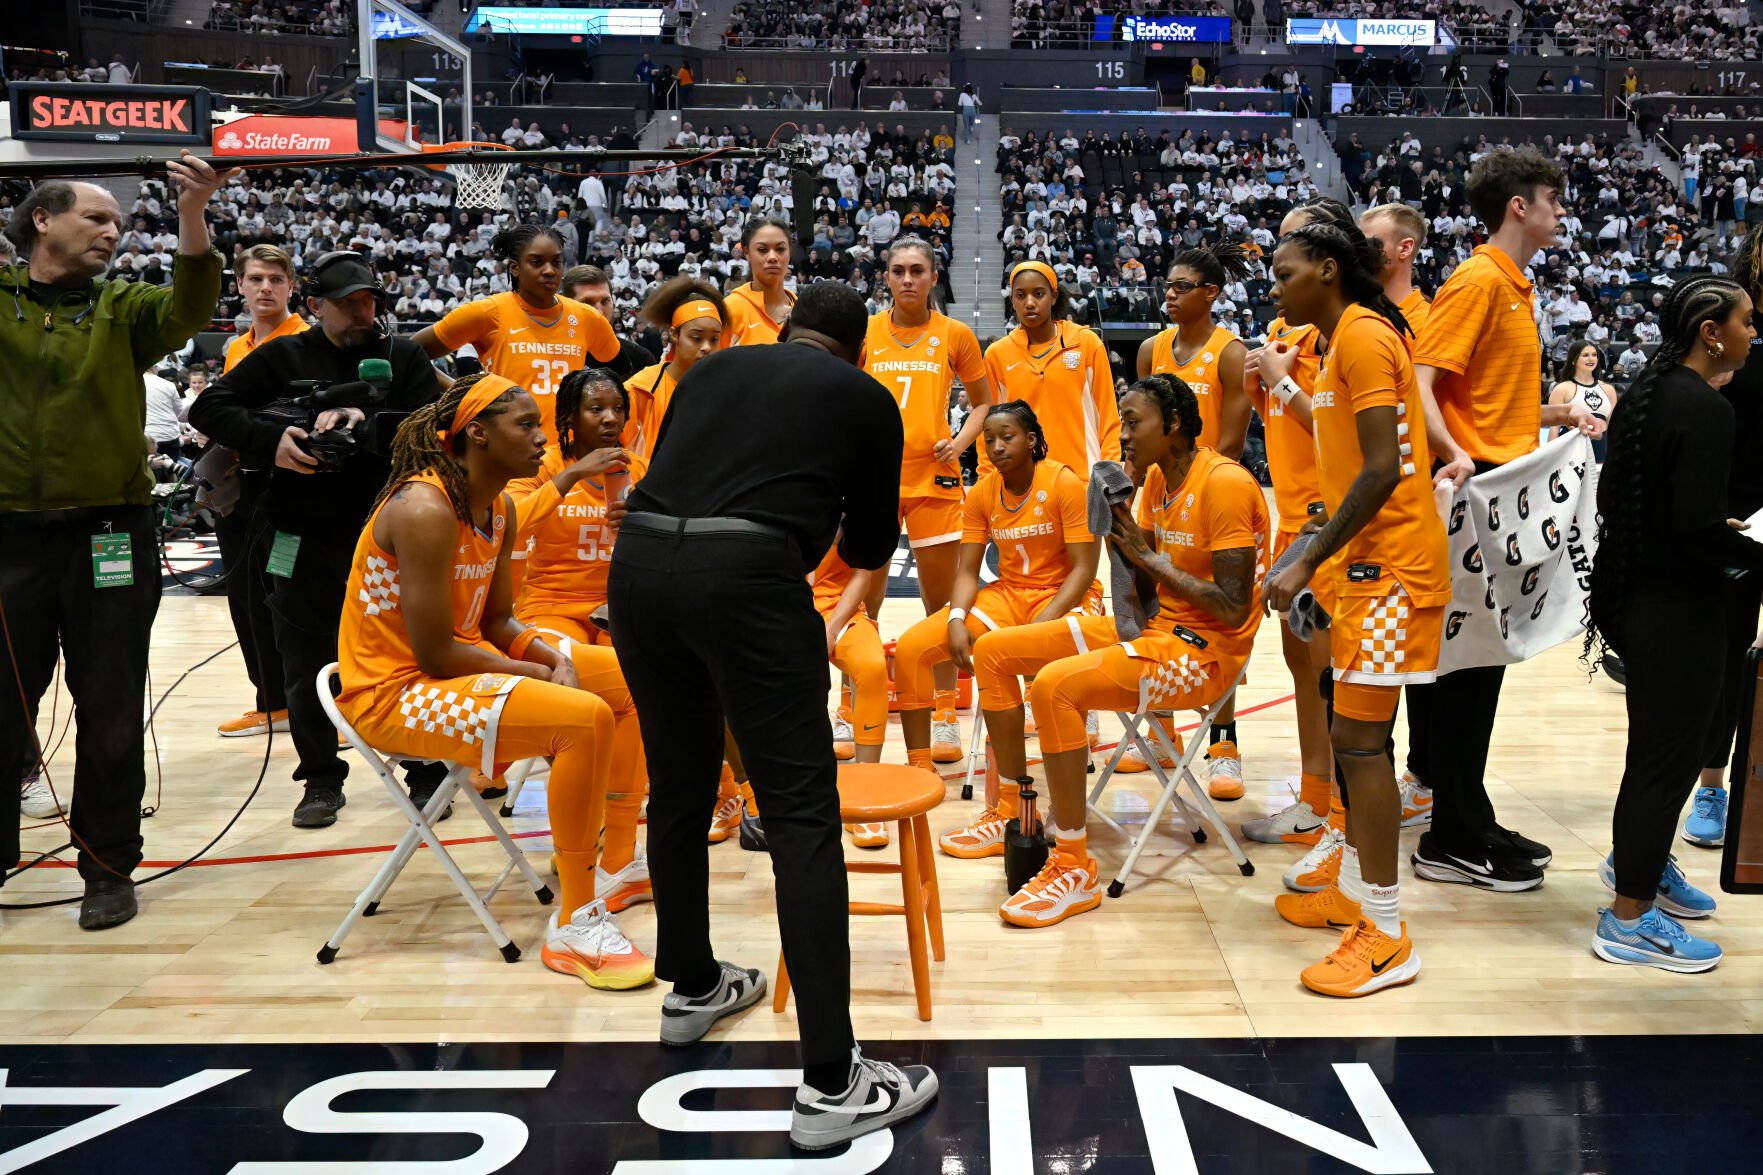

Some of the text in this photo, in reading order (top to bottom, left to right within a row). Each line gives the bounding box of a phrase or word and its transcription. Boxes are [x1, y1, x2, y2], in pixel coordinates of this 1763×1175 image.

[1137, 22, 1197, 37] EchoStor
[1362, 24, 1427, 35] MARCUS
[1096, 62, 1124, 78] 115
[1718, 71, 1746, 87] 117
[32, 95, 189, 132] SEATGEEK
[508, 342, 582, 356] TENNESSEE
[872, 360, 941, 374] TENNESSEE
[896, 376, 912, 409] 7
[990, 522, 1054, 540] ENNESSEE
[1016, 543, 1030, 576] 1
[96, 573, 132, 581] TELEVISION
